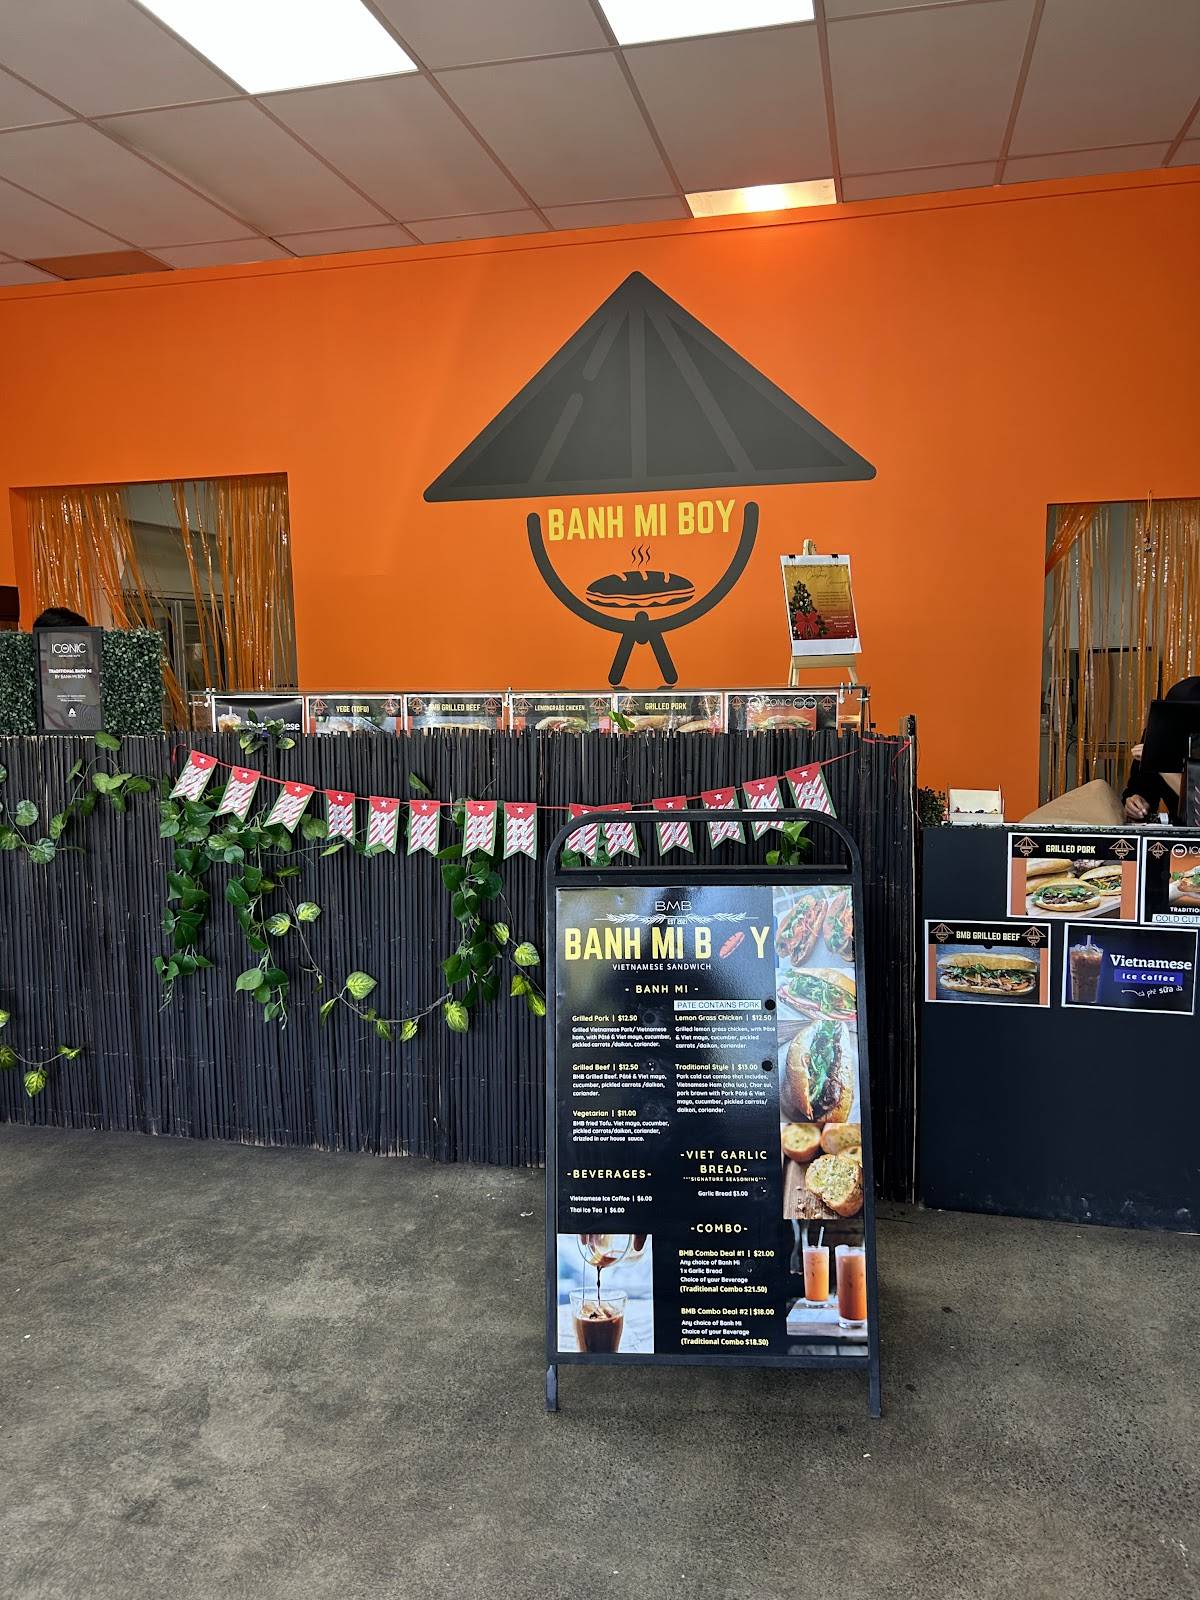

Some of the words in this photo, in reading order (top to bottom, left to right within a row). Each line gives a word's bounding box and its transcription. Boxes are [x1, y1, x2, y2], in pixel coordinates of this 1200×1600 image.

[548, 505, 623, 541] BANH
[635, 503, 666, 537] MI
[678, 499, 735, 535] BOY
[52, 643, 86, 653] ICONIC
[1046, 844, 1075, 853] GRILLED
[1077, 845, 1095, 854] PORK
[655, 901, 691, 911] BMB
[956, 931, 970, 939] BMB
[973, 931, 1001, 940] GRILLED
[1003, 933, 1020, 941] BEEF
[565, 927, 641, 960] BANH
[652, 927, 684, 959] MI
[1110, 954, 1192, 970] Vietnamese
[635, 985, 668, 993] BANH
[675, 985, 688, 993] MI
[573, 1110, 608, 1118] Vegetarian
[721, 1150, 767, 1159] GARLIC
